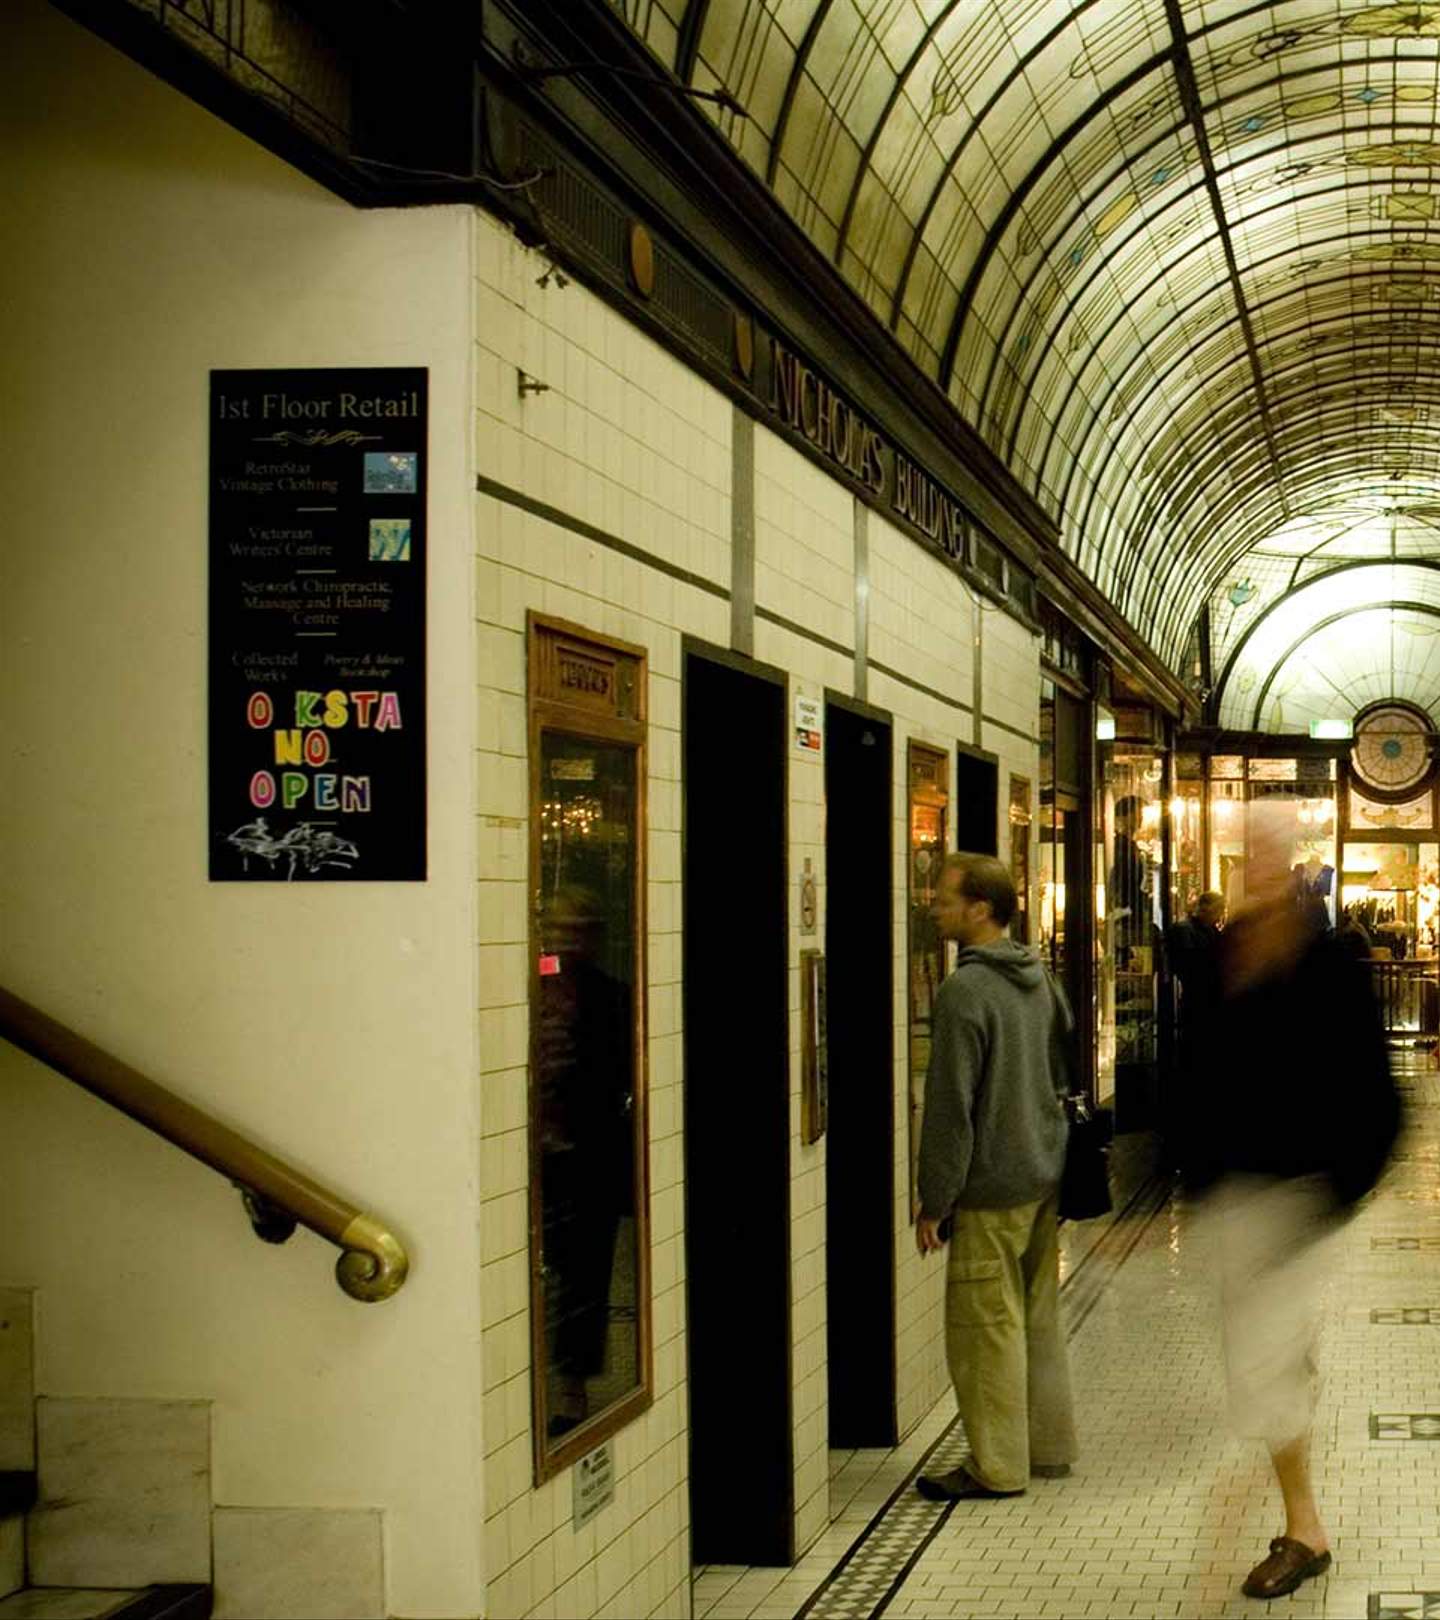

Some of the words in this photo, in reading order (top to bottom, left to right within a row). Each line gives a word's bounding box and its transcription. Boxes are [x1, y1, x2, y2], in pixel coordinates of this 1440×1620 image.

[219, 394, 250, 419] 1st
[263, 393, 332, 419] Floor
[339, 390, 418, 418] Retail
[769, 337, 885, 494] NICHOLAS
[219, 478, 274, 494] Vintage
[278, 476, 339, 493] Clothing
[285, 543, 333, 556] Centre
[307, 595, 331, 608] and
[336, 593, 392, 612] Healing
[292, 612, 341, 625] Centre
[274, 729, 330, 767] NO
[250, 770, 371, 813] OPEN
